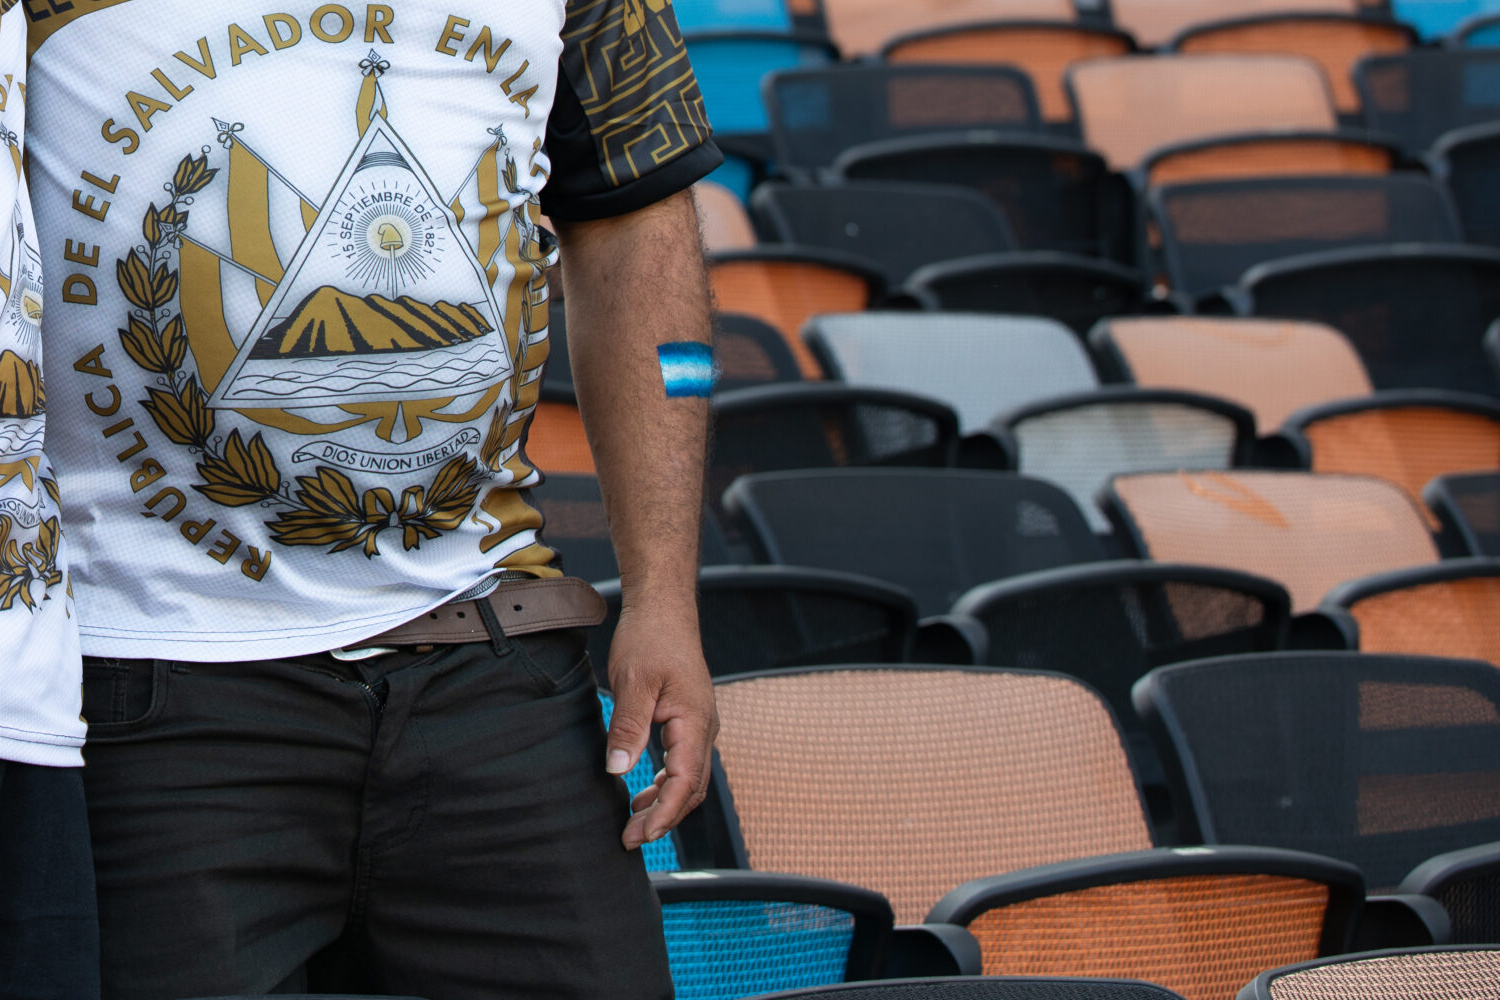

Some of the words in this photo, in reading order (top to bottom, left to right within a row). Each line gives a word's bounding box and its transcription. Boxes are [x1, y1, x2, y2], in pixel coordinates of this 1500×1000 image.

[435, 14, 512, 73] EN
[101, 3, 394, 155] SALVADOR
[72, 170, 121, 222] EL
[340, 191, 414, 239] SEPTIEMBRE
[414, 204, 433, 223] DE
[342, 244, 357, 259] 15
[423, 225, 435, 255] 1821
[62, 238, 100, 306] DE
[73, 344, 272, 582] REPÚBLICA
[322, 445, 357, 465] DIOS
[359, 455, 413, 471] UNION
[416, 431, 469, 467] LIBERTAD
